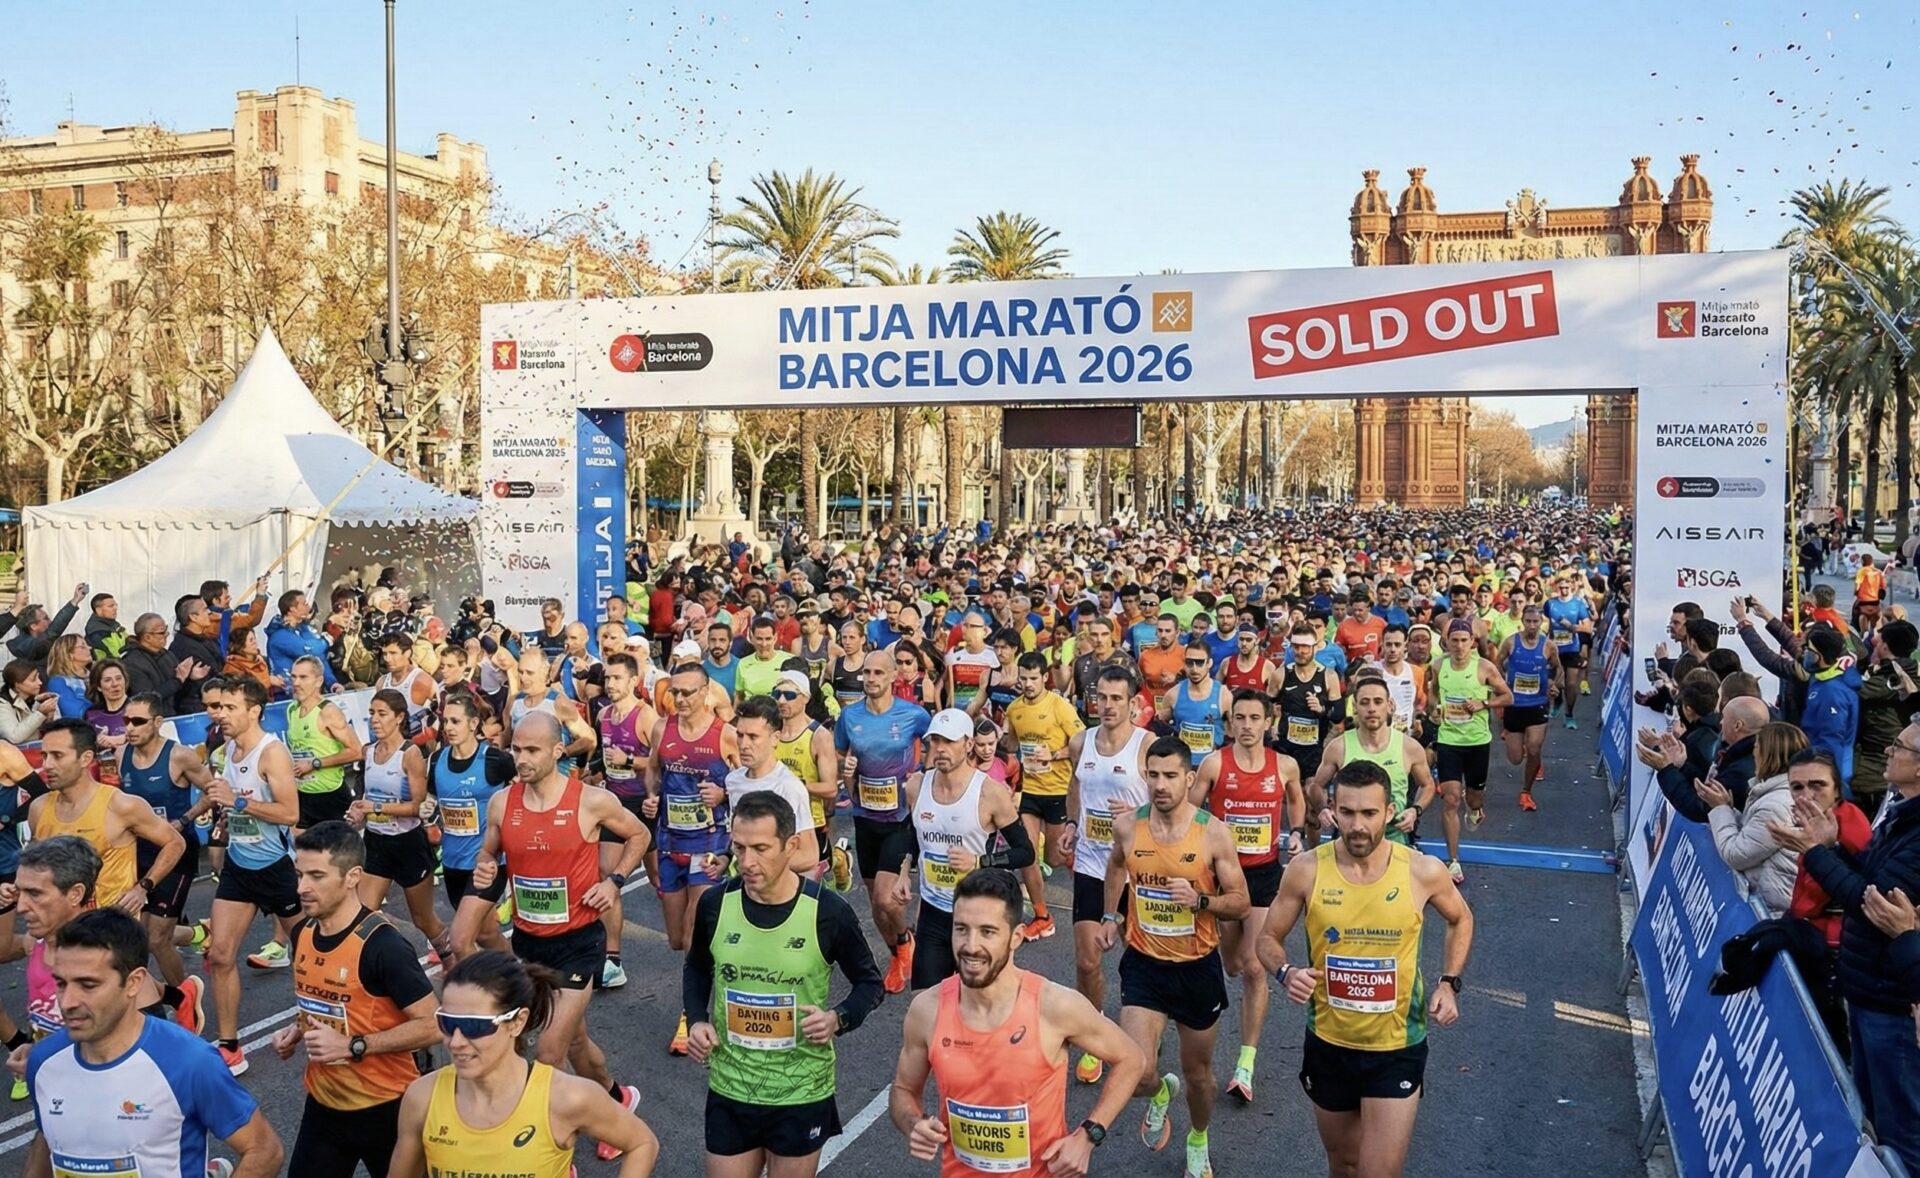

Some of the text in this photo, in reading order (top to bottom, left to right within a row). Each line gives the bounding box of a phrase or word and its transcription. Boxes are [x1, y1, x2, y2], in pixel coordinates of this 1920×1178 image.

[778, 283, 1142, 343] MITJA MARATÓ
[1260, 283, 1544, 366] SOLD OUT
[1701, 325, 1769, 337] Barcelona
[648, 350, 702, 363] Barcelona
[778, 343, 1193, 390] BARCELONA 2026
[1656, 421, 1754, 435] MITJA MARATÓ
[1656, 436, 1768, 447] BARCELONA 2026
[492, 449, 544, 458] BARCELONA
[1650, 884, 1694, 1029] BARCELONA
[1329, 971, 1393, 986] BARCELONA
[1346, 985, 1376, 998] 2026
[1719, 986, 1770, 1086] MITJA
